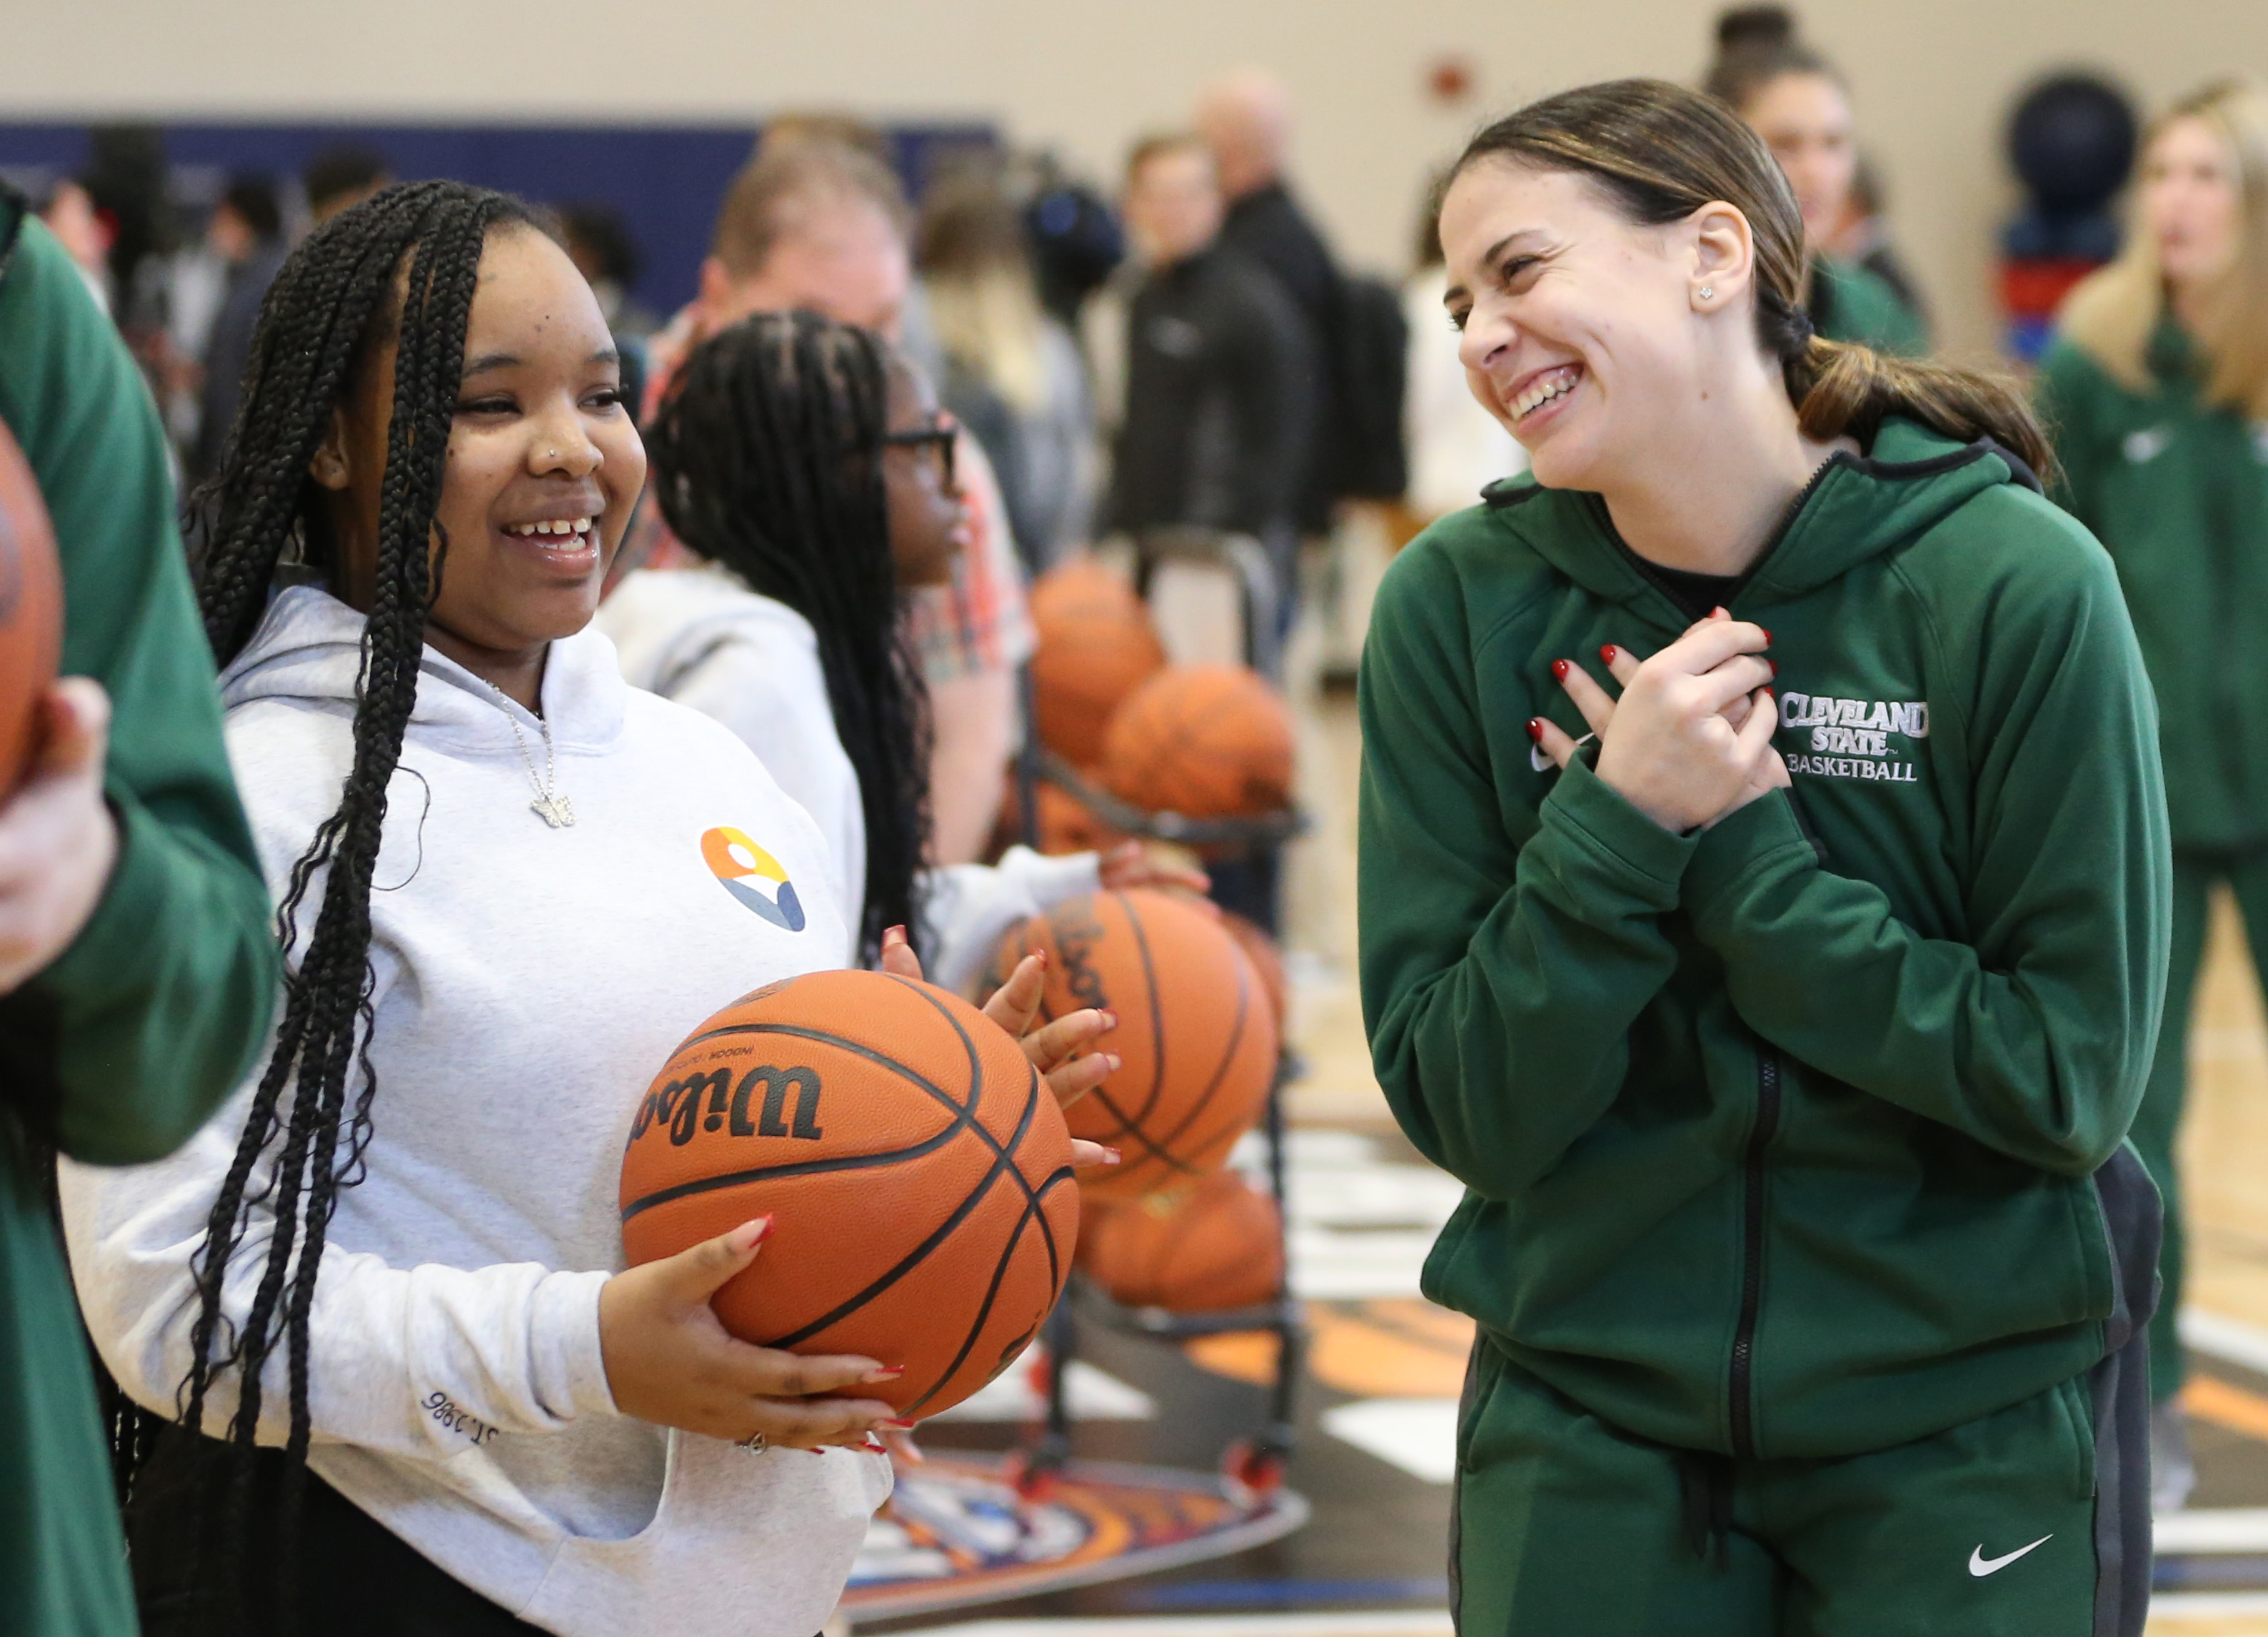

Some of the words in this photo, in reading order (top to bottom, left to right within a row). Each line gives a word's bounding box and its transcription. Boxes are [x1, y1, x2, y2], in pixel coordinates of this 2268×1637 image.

[1778, 692, 1930, 739] CLEVELAND
[1810, 726, 1889, 757] STATE
[1787, 753, 1918, 782] BASKETBALL
[626, 1064, 823, 1148] Wilso
